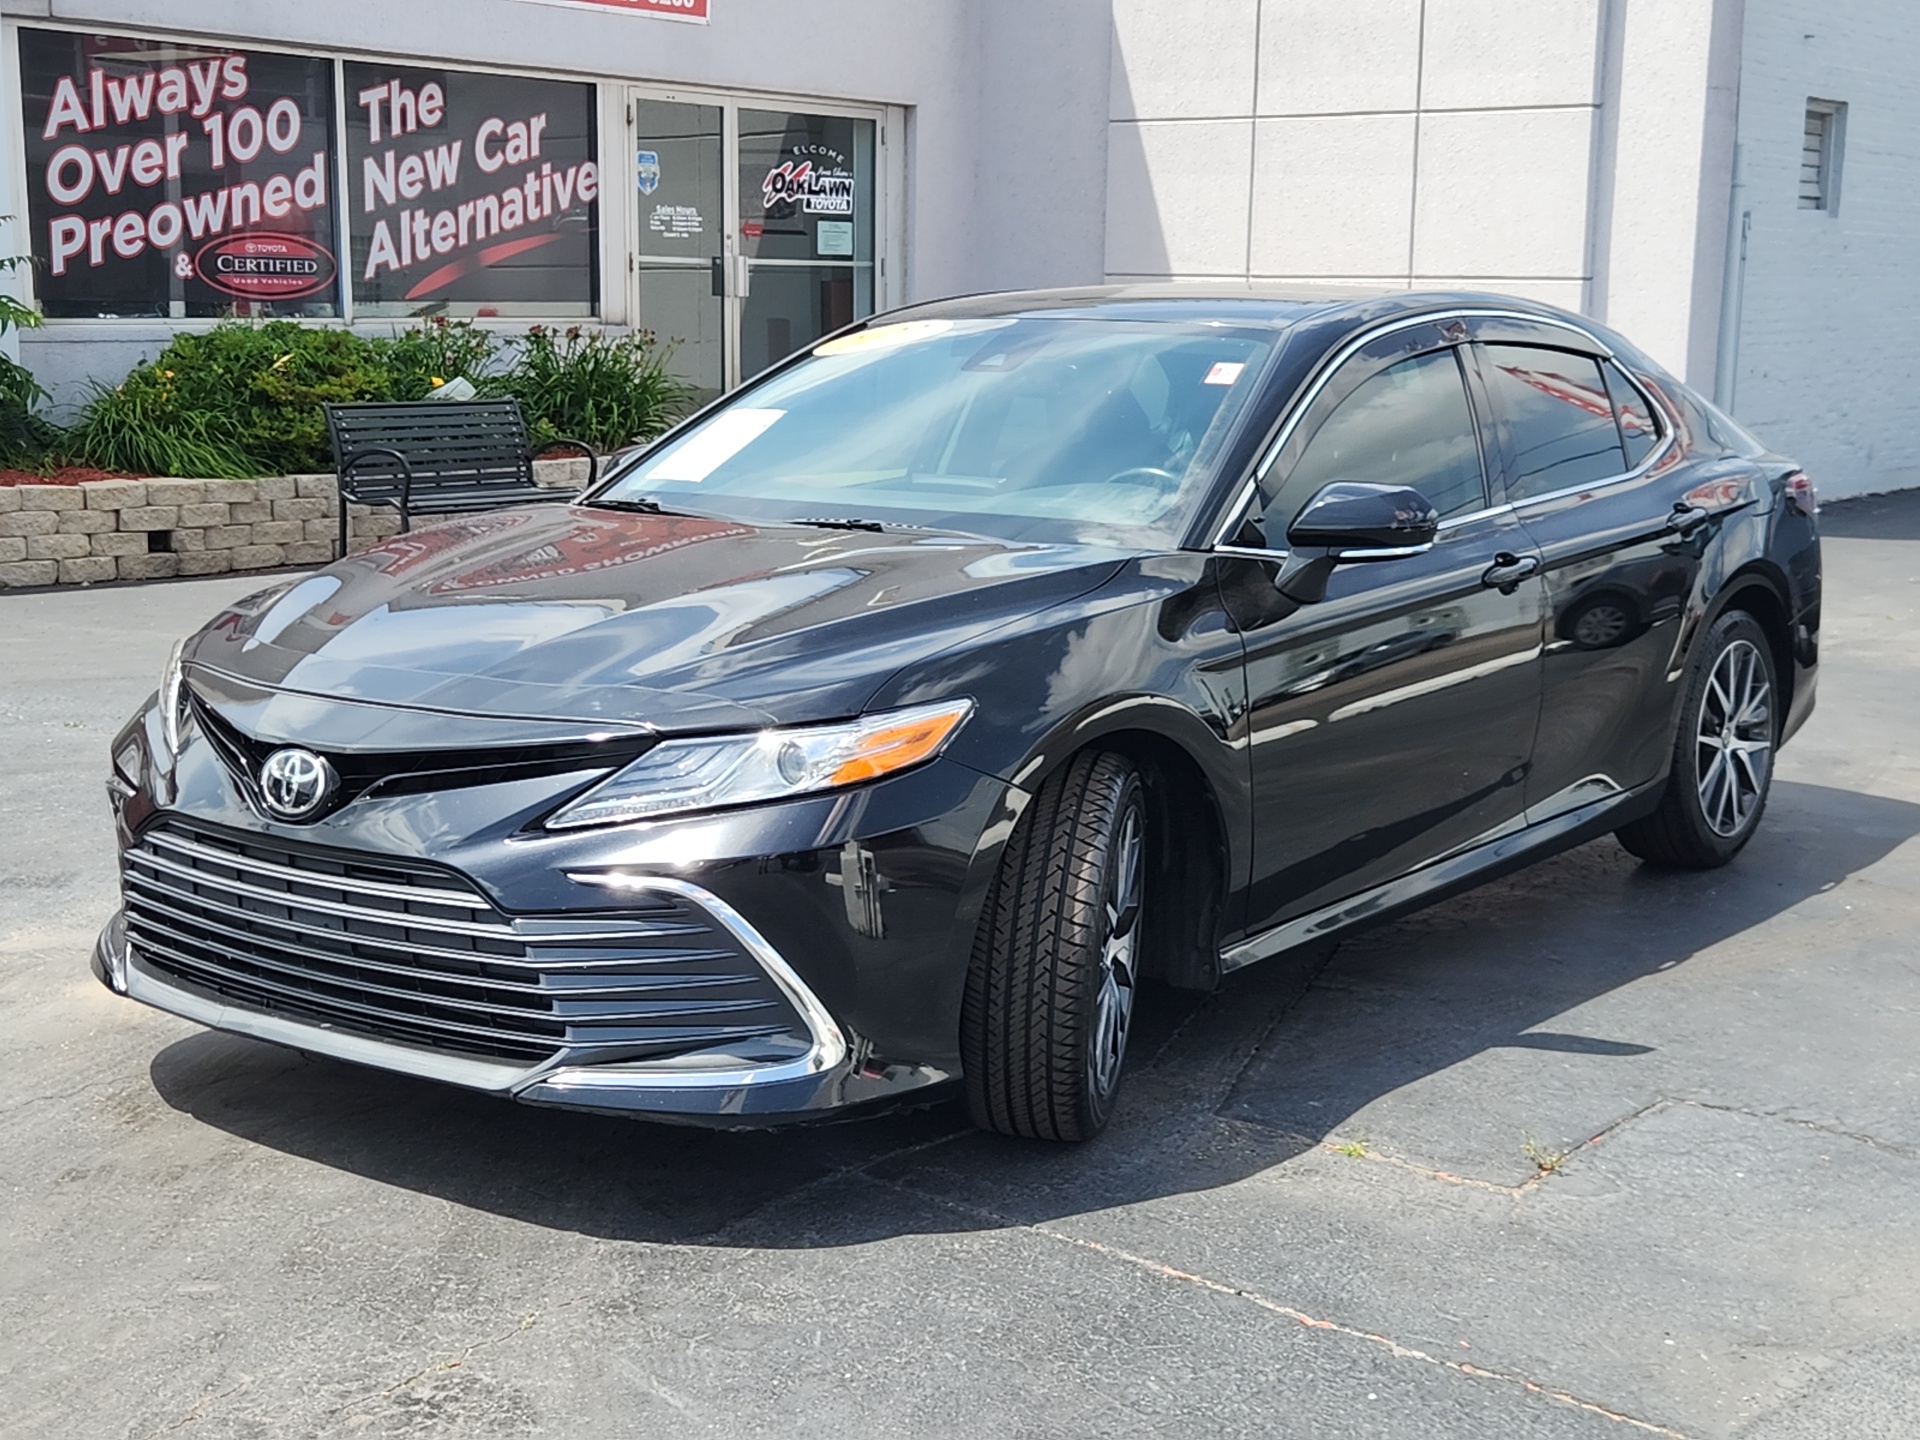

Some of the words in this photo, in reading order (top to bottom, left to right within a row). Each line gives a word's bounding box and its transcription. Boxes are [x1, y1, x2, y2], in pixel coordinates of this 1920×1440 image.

[42, 53, 248, 140] Always
[359, 79, 444, 144] The
[45, 131, 188, 205] Over
[203, 97, 301, 170] 100
[362, 140, 461, 212] New
[474, 112, 547, 175] Car
[793, 145, 845, 164] ELCOME
[49, 153, 327, 277] Preowned
[363, 158, 598, 280] Alternative
[810, 198, 848, 211] TOYOTA
[175, 253, 194, 278] &
[256, 243, 287, 253] TOYOTA
[233, 277, 258, 285] Used
[262, 278, 303, 286] Vehicles
